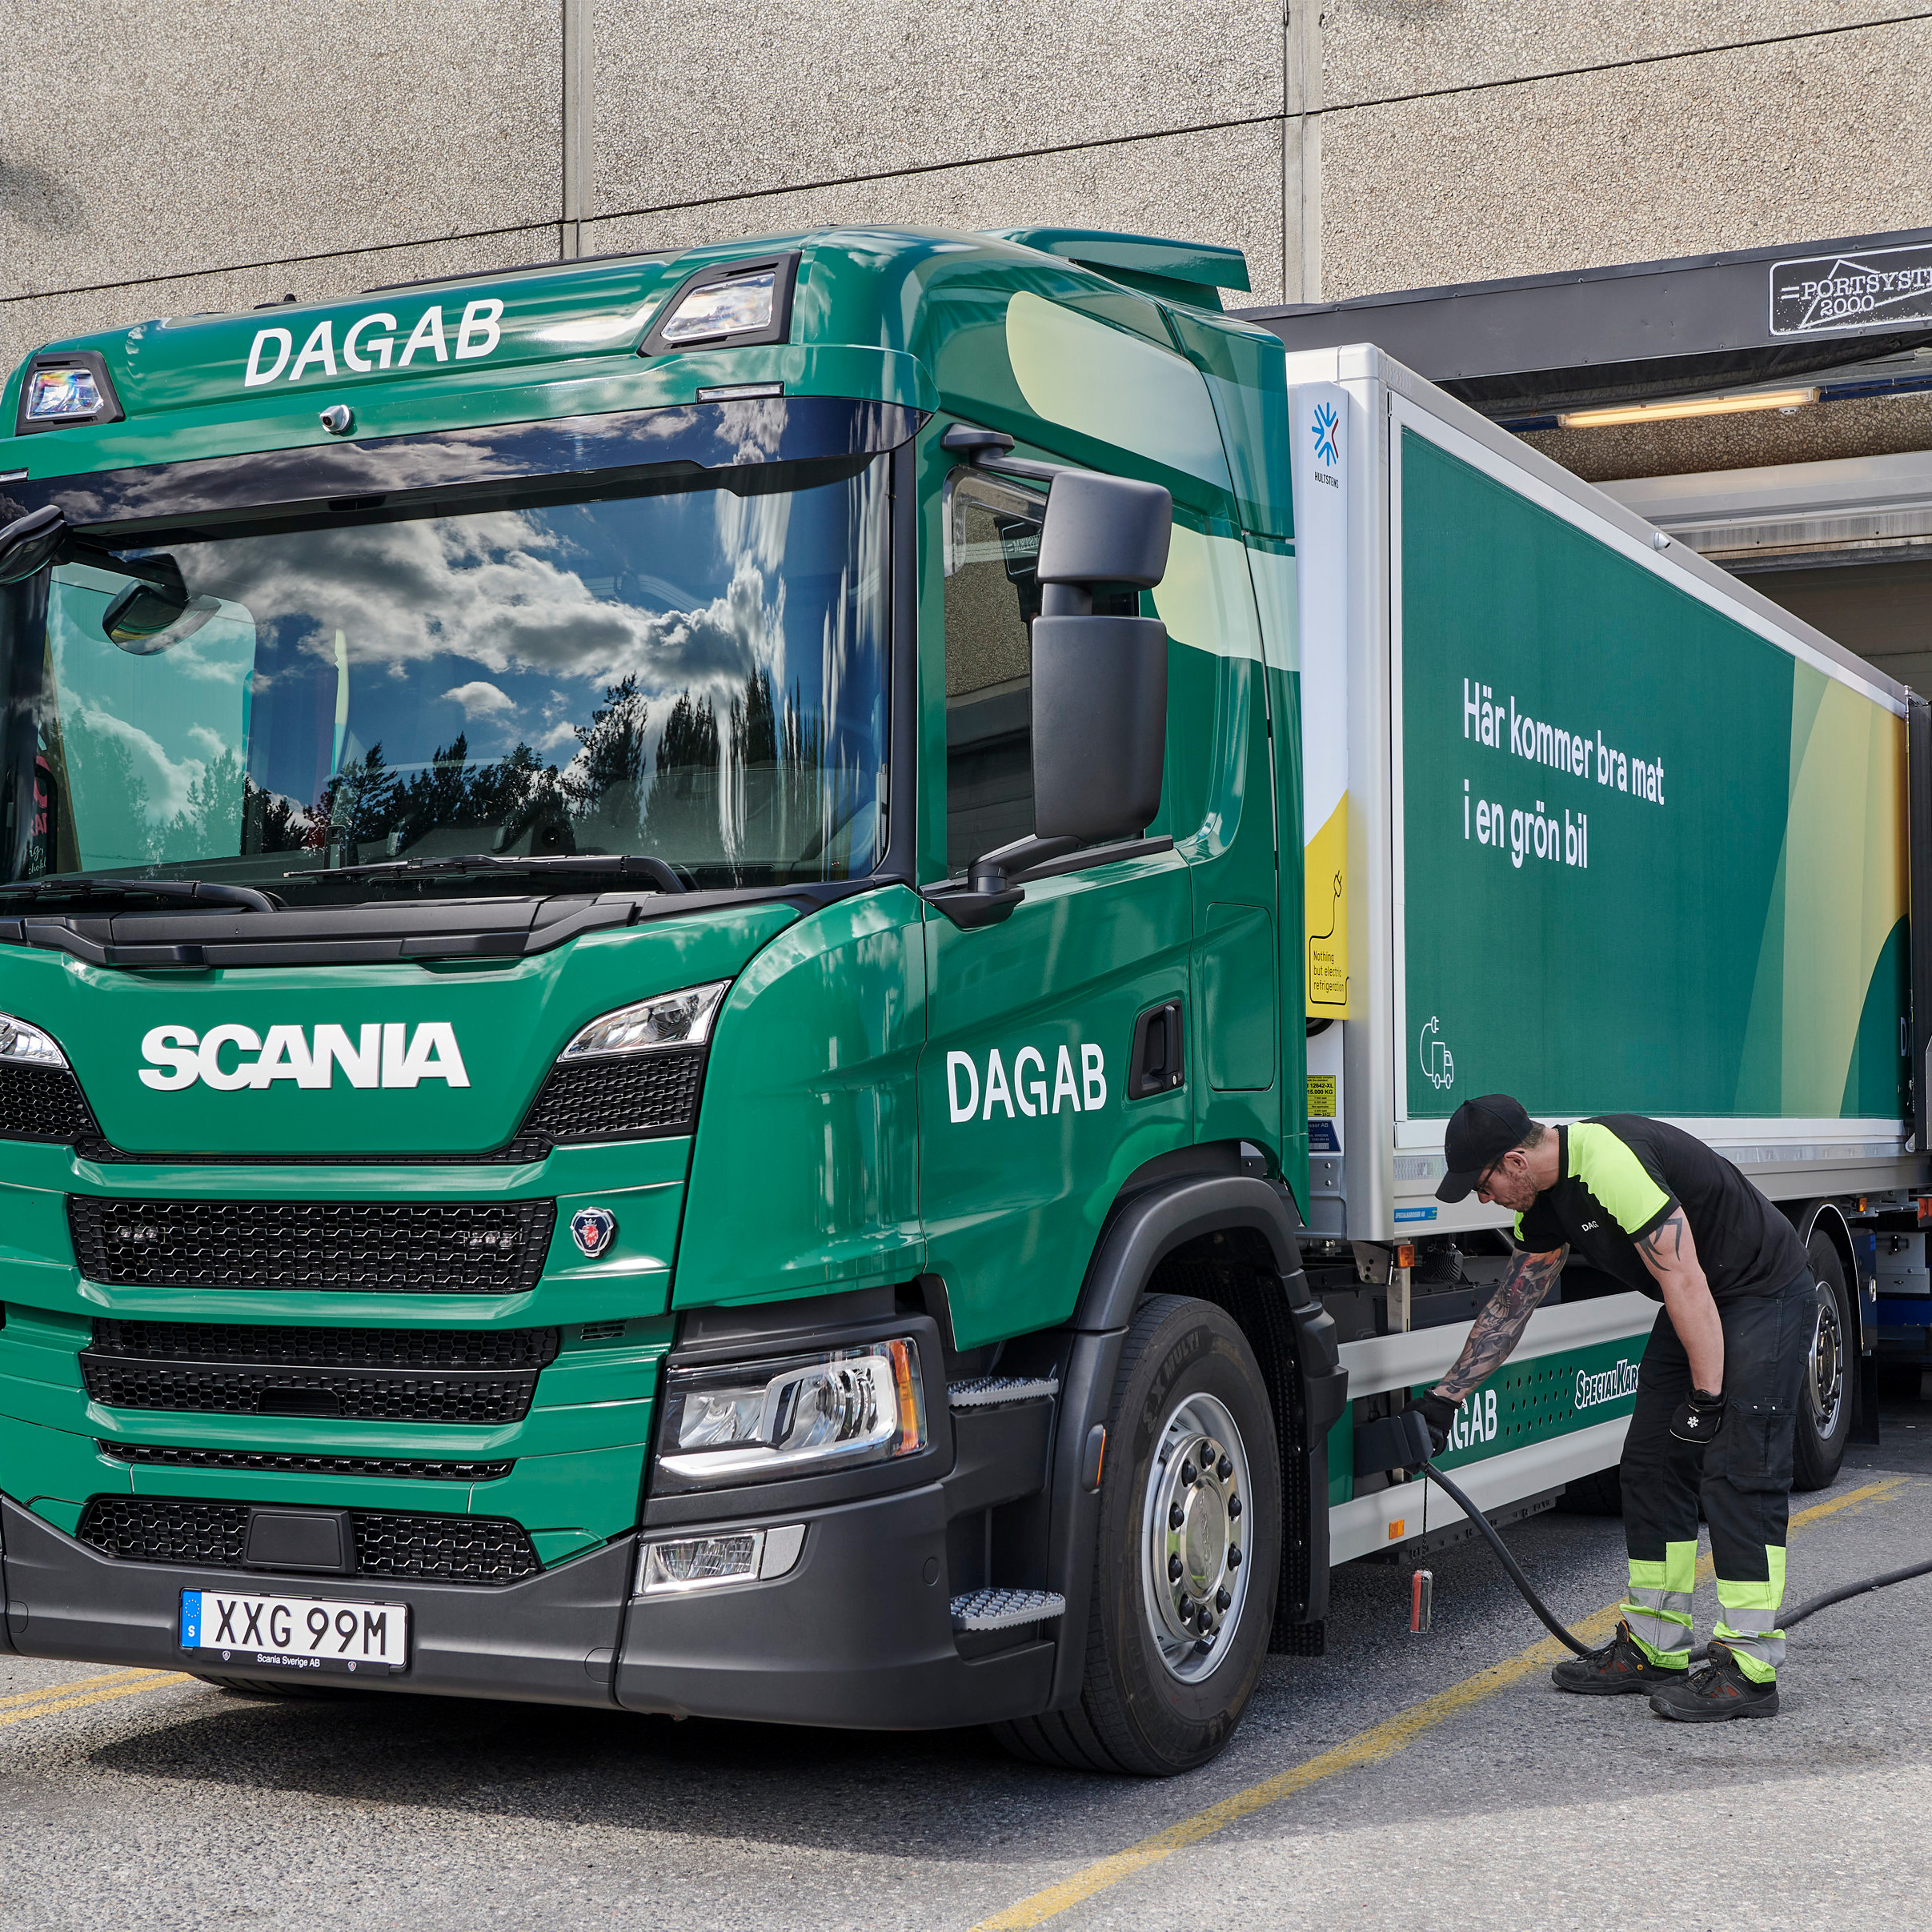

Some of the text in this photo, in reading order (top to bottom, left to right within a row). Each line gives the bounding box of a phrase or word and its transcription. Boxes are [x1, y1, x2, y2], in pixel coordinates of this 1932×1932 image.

[1819, 295, 1875, 316] 2000
[244, 298, 504, 387] DAGAB
[1314, 471, 1339, 489] HULTSTEINS
[1464, 678, 1665, 806] Här kommer bra mat
[1464, 780, 1589, 869] i en grön bil
[1313, 950, 1335, 964] Nothing
[1313, 965, 1342, 978] but electric
[1313, 980, 1344, 993] refrigeration
[138, 1022, 471, 1091] SCANIA
[947, 1043, 1108, 1123] DAGAB
[1581, 1221, 1599, 1232] DAG
[1164, 1331, 1201, 1379] MULTI
[1447, 1389, 1498, 1452] GAB
[188, 1599, 387, 1656] S XXG 99M
[257, 1653, 320, 1669] Scania Sverige AB
